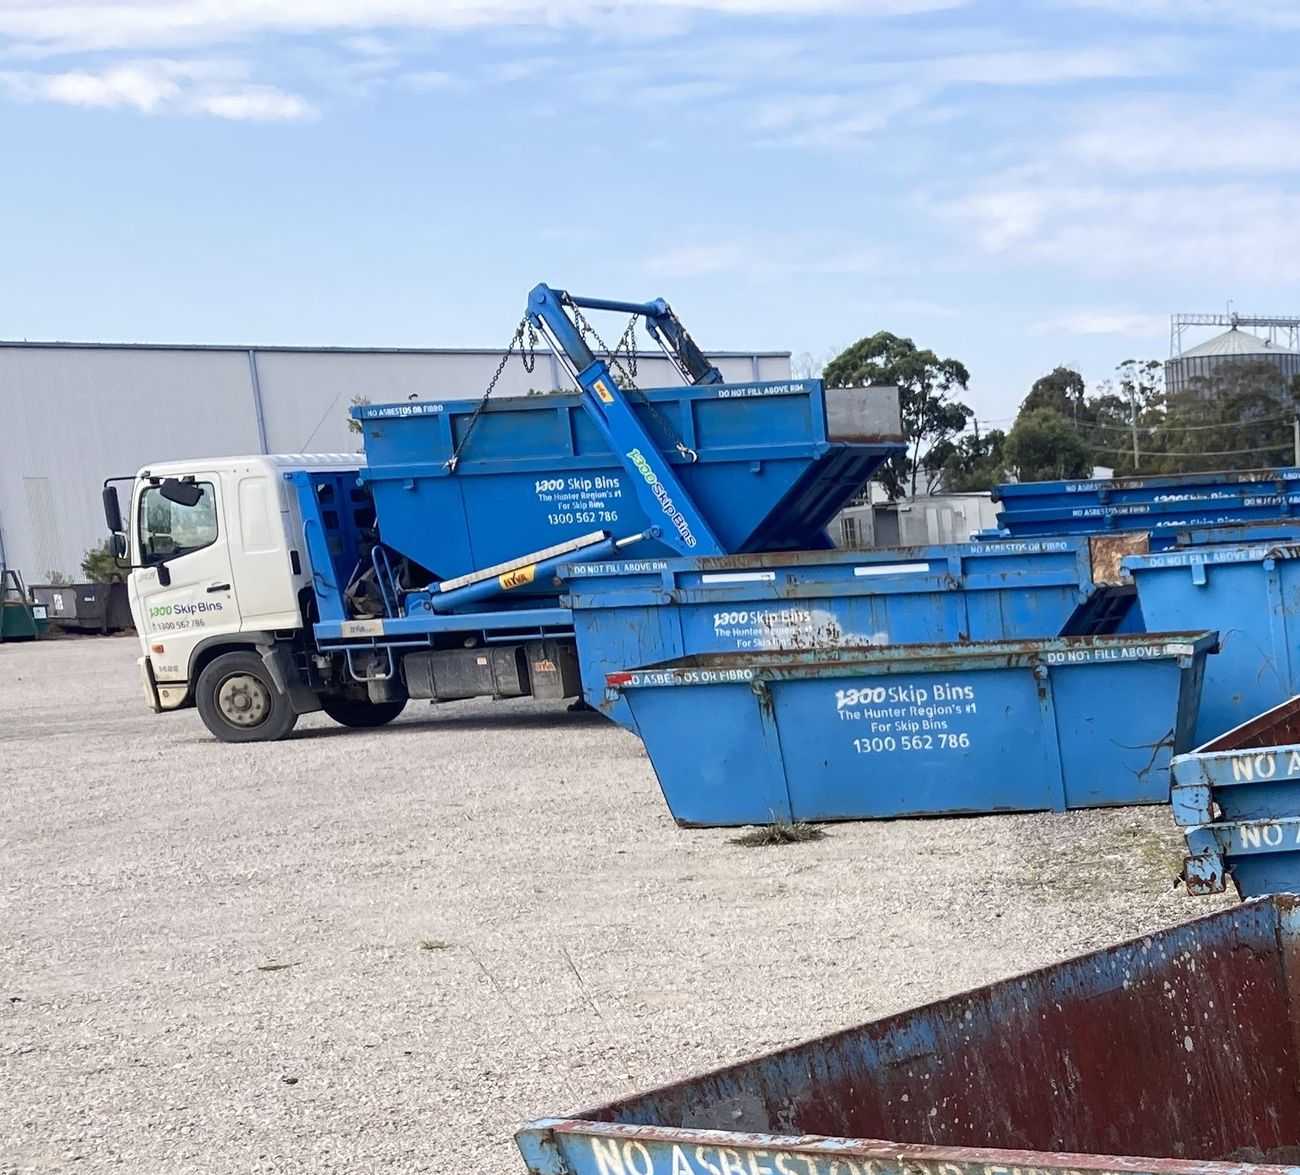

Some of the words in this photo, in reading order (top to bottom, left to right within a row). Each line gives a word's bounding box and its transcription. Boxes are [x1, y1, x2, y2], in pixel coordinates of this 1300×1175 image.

[719, 390, 729, 398] DO
[731, 389, 746, 397] NOT
[747, 388, 762, 396] FILL
[764, 386, 789, 394] ABOVE
[535, 479, 564, 493] 1300
[567, 477, 592, 491] Skip
[595, 475, 620, 489] Bins
[538, 494, 553, 502] The
[553, 492, 579, 500] Hunter
[581, 490, 613, 500] Region's
[626, 448, 657, 484] 1300
[652, 482, 676, 516] Skip
[671, 512, 696, 548] Bins
[572, 501, 588, 510] Skip
[588, 500, 605, 508] Bins
[547, 513, 574, 525] 1300
[576, 512, 596, 523] 562
[599, 511, 618, 522] 786
[1150, 558, 1164, 566] DO
[1167, 556, 1187, 565] NOT
[1190, 554, 1209, 565] FILL
[1213, 551, 1248, 561] ABOVE
[574, 566, 586, 574] DO
[587, 564, 604, 574] NOT
[623, 562, 651, 572] ABOVE
[652, 561, 667, 570] RIM
[503, 571, 528, 588] HYVA
[149, 606, 172, 619] 1300
[173, 604, 197, 615] Skip
[198, 602, 222, 612] Bins
[158, 622, 175, 630] 1300
[713, 611, 748, 628] 1300
[750, 610, 778, 627] Skip
[715, 628, 731, 637] The
[732, 627, 762, 636] Hunter
[737, 639, 752, 648] For
[1047, 653, 1065, 663] DO
[1095, 649, 1118, 660] FILL
[1120, 646, 1160, 658] ABOVE
[701, 671, 717, 681] OR
[719, 669, 753, 681] FIBRO
[835, 688, 886, 709] 1300
[888, 685, 927, 705] Skip
[933, 683, 974, 700] Bins
[838, 710, 860, 720] The
[864, 708, 906, 719] Hunter
[910, 704, 961, 718] Region's
[965, 703, 976, 713] #1
[871, 722, 891, 733] For
[895, 720, 919, 733] Skip
[922, 719, 947, 731] Bins
[853, 737, 896, 753] 1300
[902, 735, 933, 751] 562
[938, 733, 970, 748] 786
[1232, 754, 1276, 781] NO
[1240, 824, 1283, 849] NO
